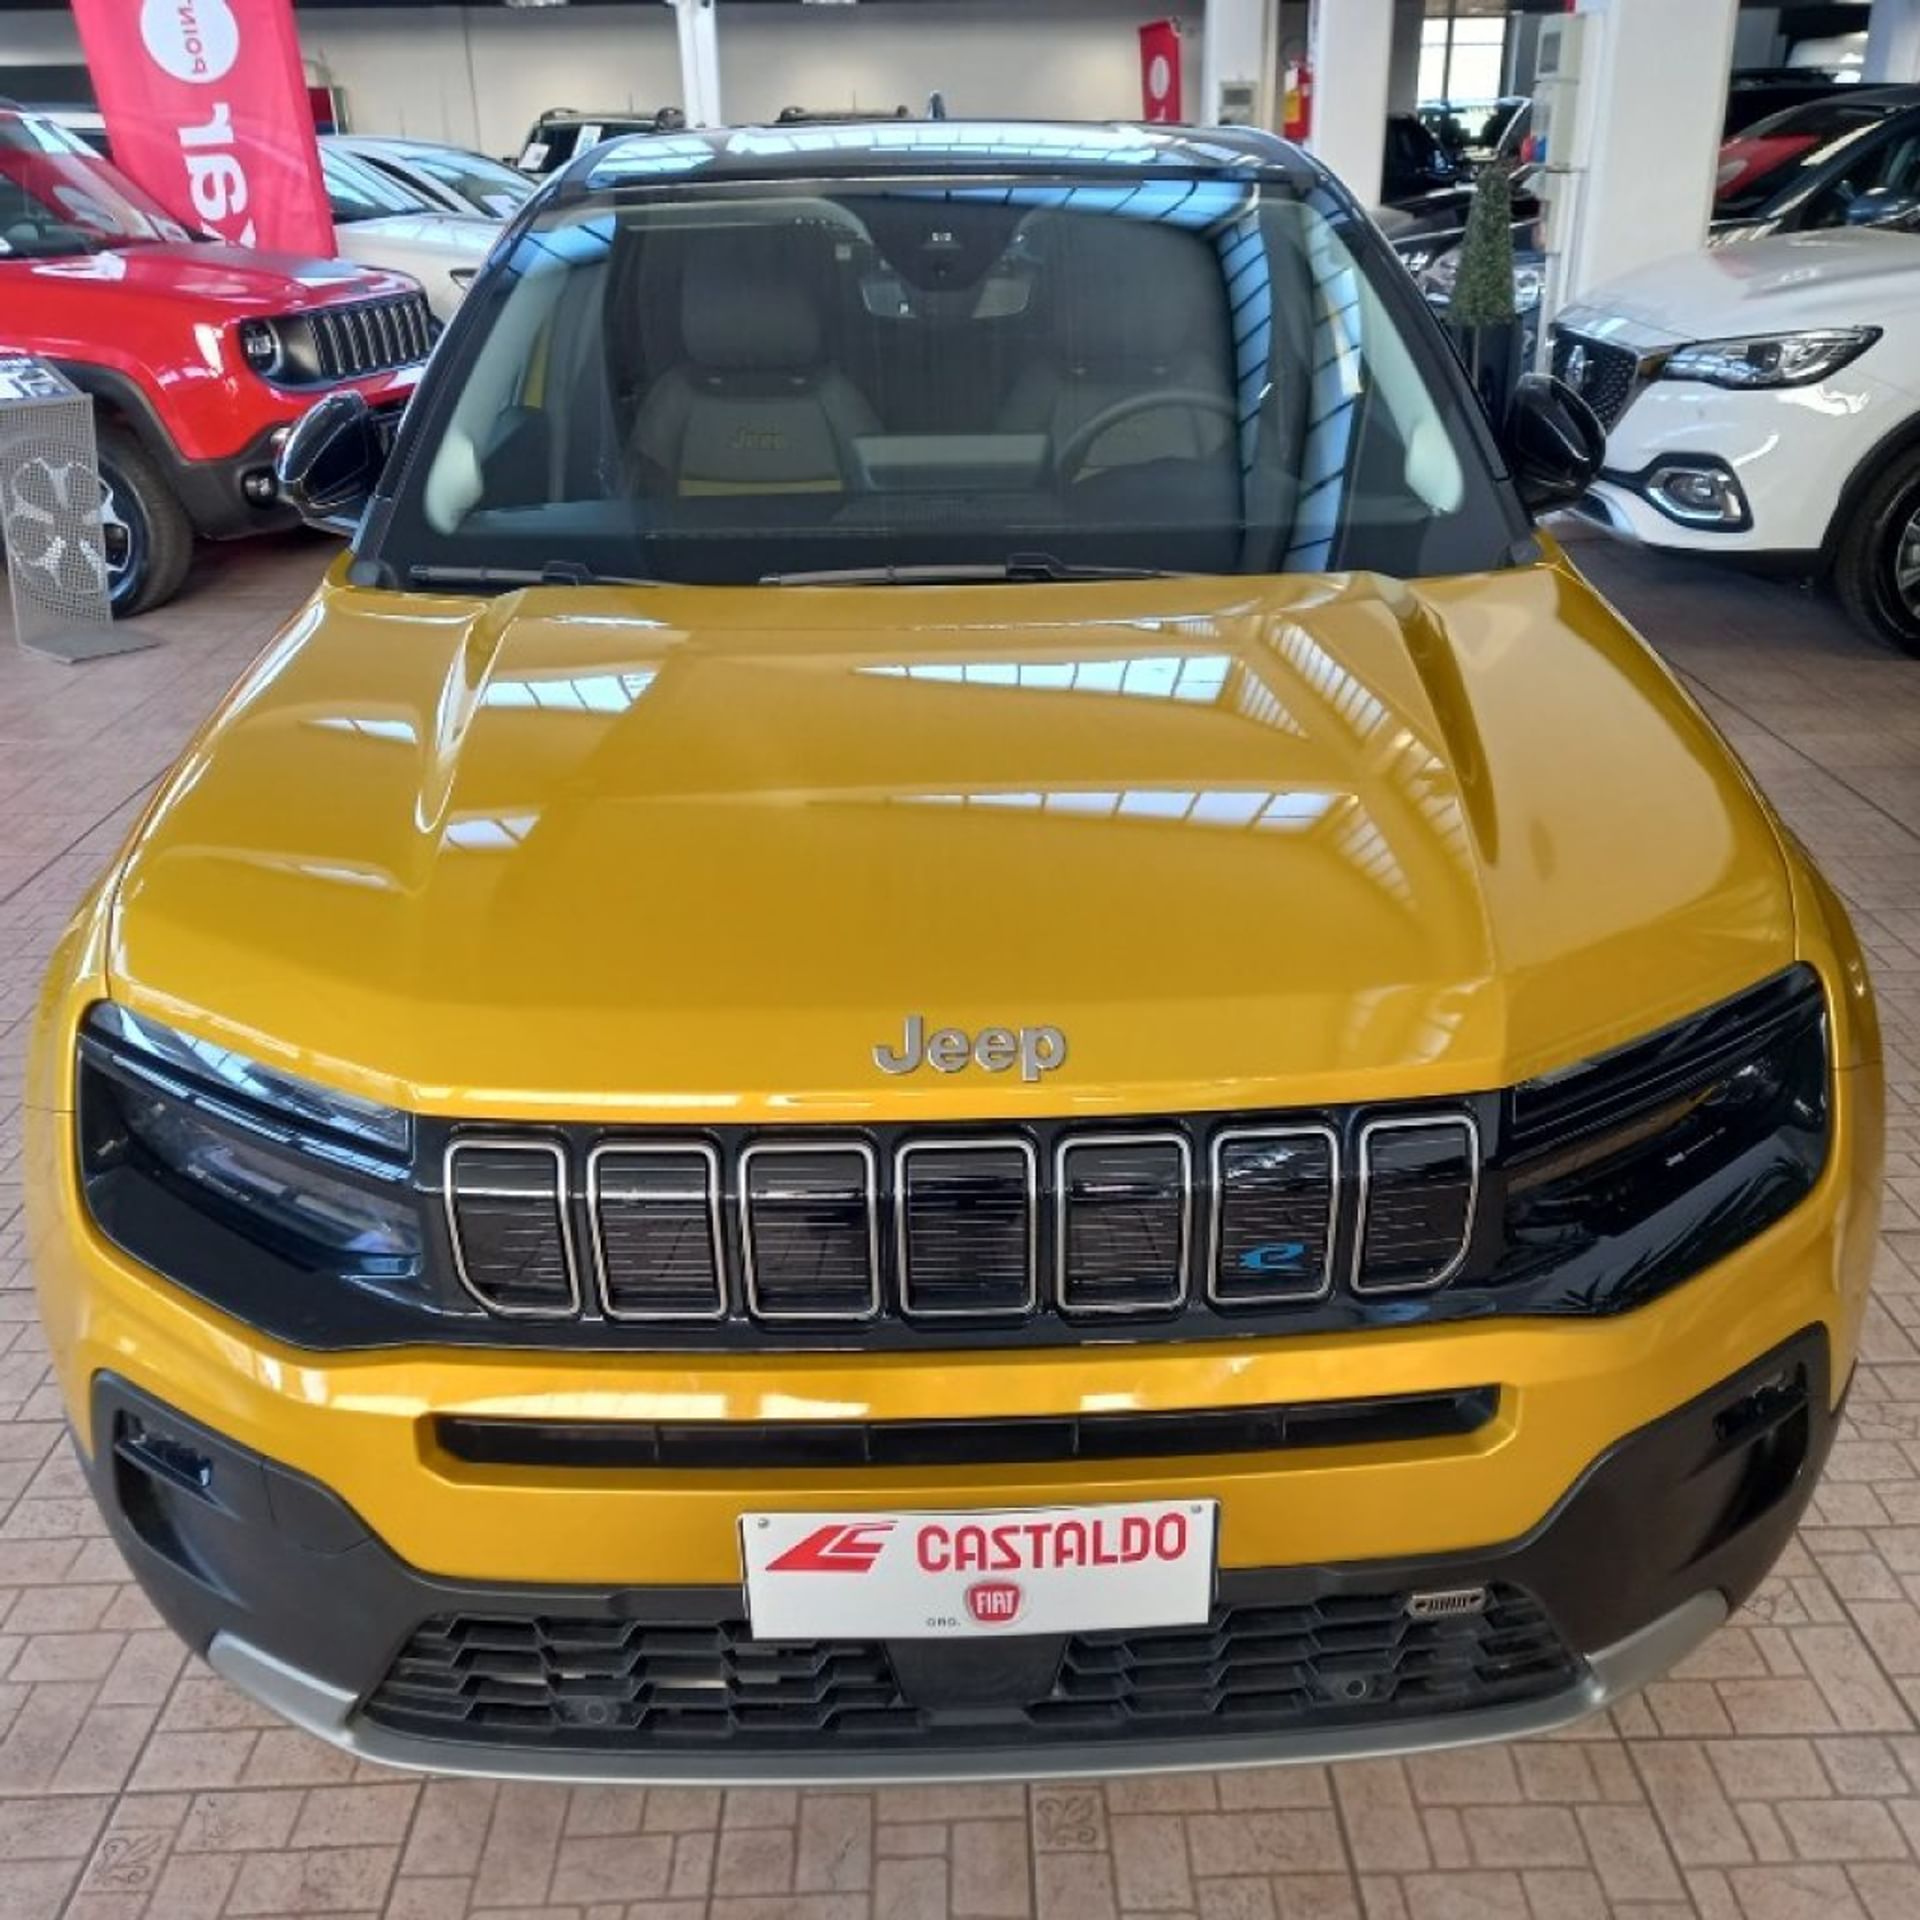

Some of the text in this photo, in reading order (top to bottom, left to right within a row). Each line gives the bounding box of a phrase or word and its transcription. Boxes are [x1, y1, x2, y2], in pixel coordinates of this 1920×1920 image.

[873, 1014, 1066, 1083] Jeep
[917, 1512, 1187, 1572] CASTALDO
[975, 1590, 1017, 1615] FIAT
